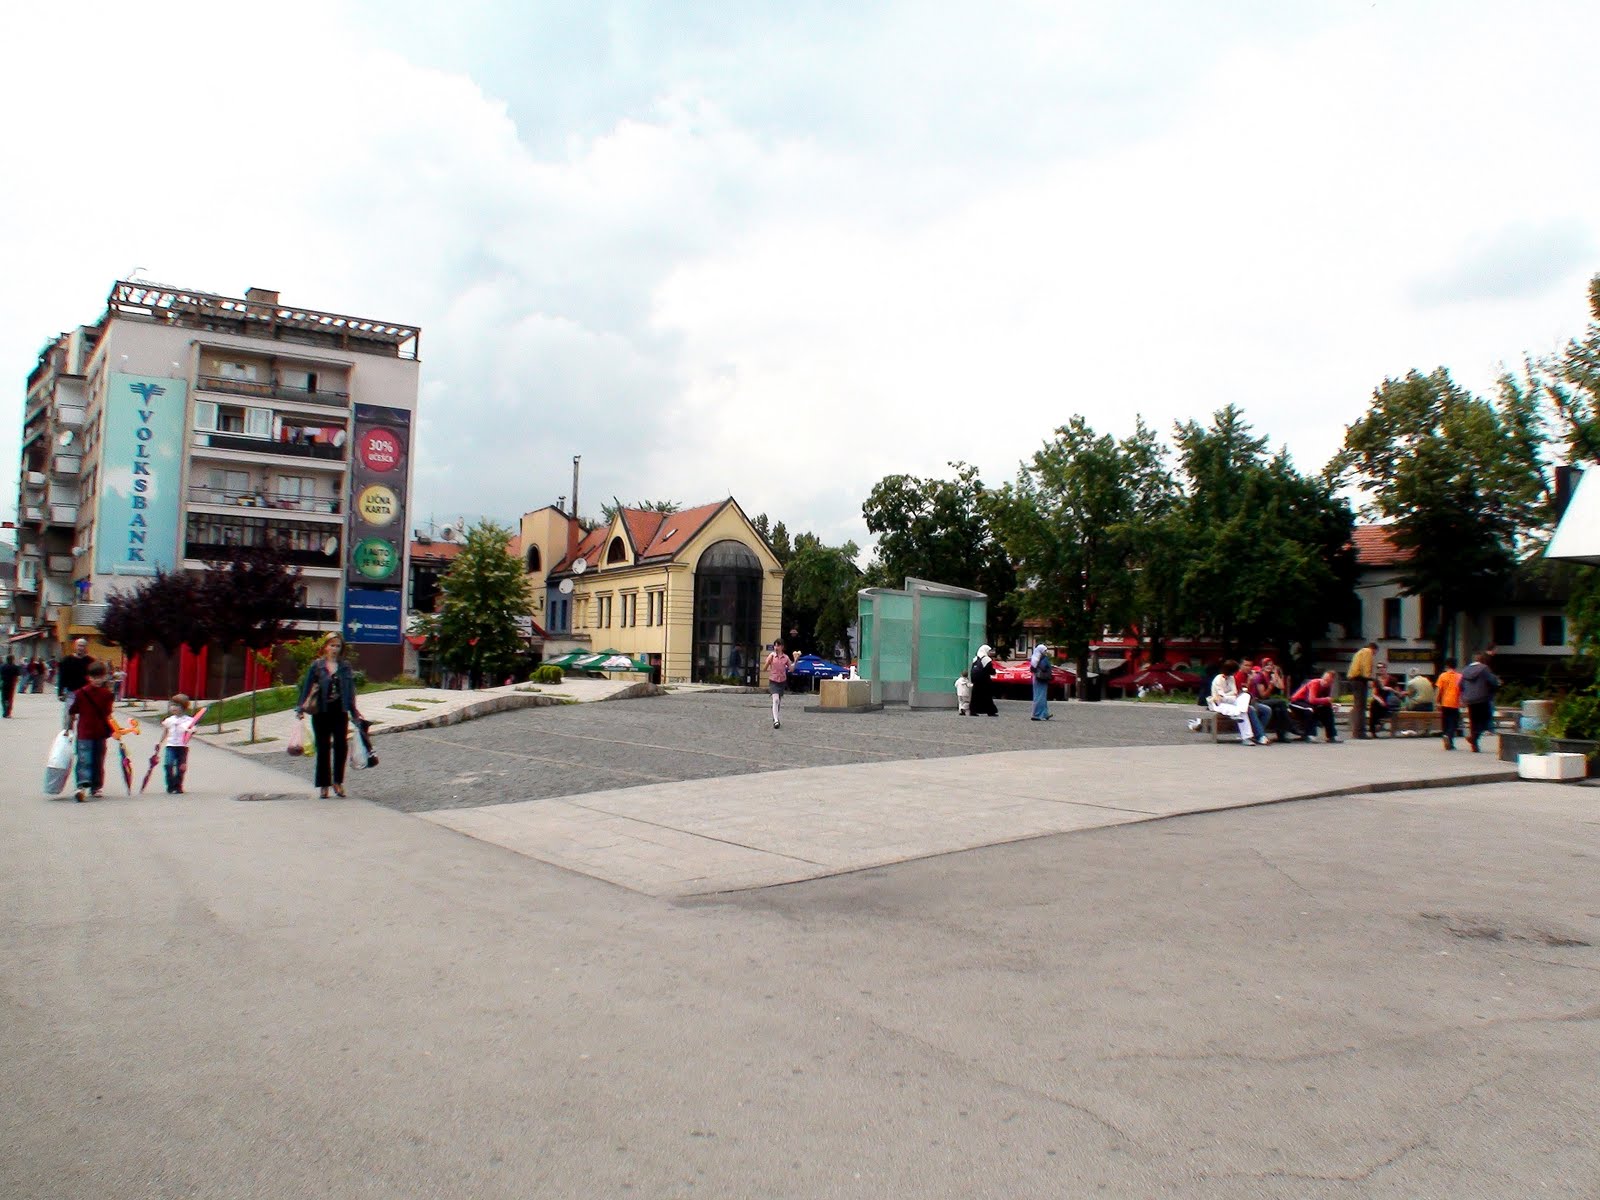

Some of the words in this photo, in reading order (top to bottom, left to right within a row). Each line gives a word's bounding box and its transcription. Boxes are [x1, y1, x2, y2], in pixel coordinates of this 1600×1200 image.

[368, 439, 394, 453] 30%
[128, 410, 154, 561] VOLKSBANK
[365, 505, 391, 515] KARTA
